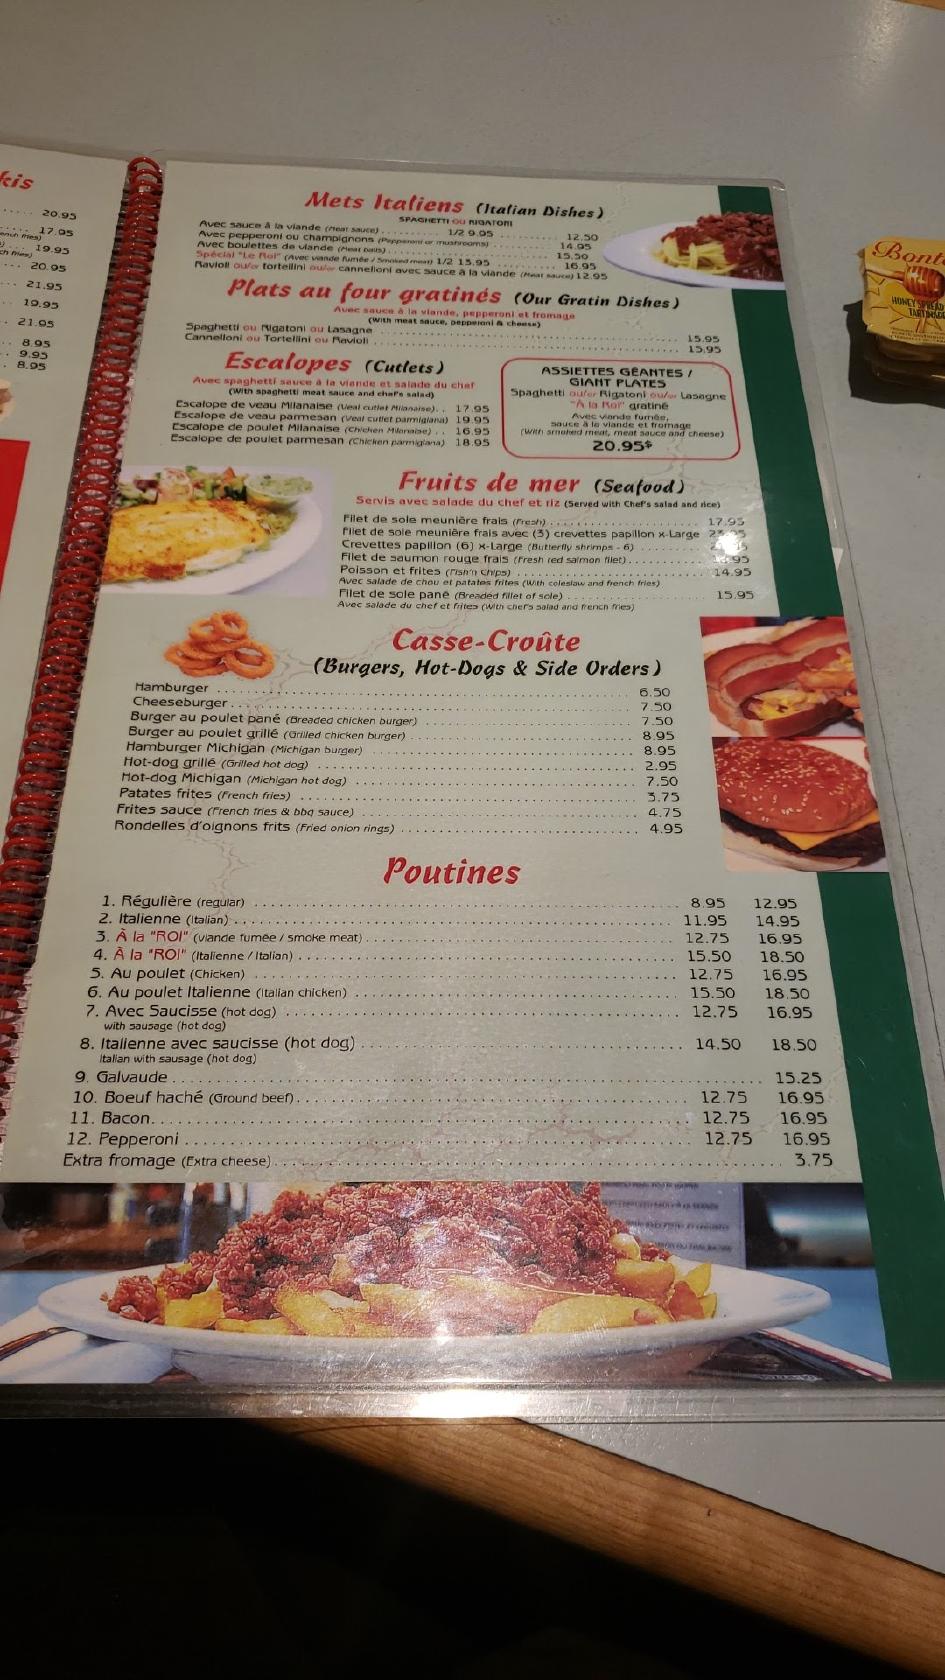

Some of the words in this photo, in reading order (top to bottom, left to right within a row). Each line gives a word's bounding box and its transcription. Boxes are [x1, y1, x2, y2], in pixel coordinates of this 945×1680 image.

[305, 192, 364, 209] Mets
[374, 194, 464, 213] Italiens
[476, 203, 537, 217] (Italian
[543, 206, 604, 220] Dishes)
[42, 210, 77, 220] 20.95
[399, 216, 449, 224] SPAGHETTI
[469, 219, 513, 227] RIGATONI
[200, 220, 226, 228] Avec
[287, 223, 321, 231] viande
[351, 226, 378, 234] sauce)
[567, 233, 598, 241] 12.50
[31, 262, 66, 272] 20.95
[227, 279, 291, 298] Plats
[300, 285, 332, 298] au
[340, 282, 391, 304] four
[399, 283, 501, 305] gratinés
[514, 292, 551, 306] (Our
[558, 294, 609, 307] Gratin
[616, 296, 679, 309] Dishes)
[24, 299, 59, 309] 19.95
[891, 296, 916, 307] HONEY
[186, 322, 240, 332] Spaghetti
[261, 324, 306, 334] Rigatoni
[328, 326, 372, 335] Lasagne
[687, 335, 720, 343] 15.95
[22, 339, 50, 348] 8.95
[225, 352, 352, 375] Escalopes
[366, 360, 444, 375] (Cutlets)
[542, 367, 614, 376] ASSIETTES
[620, 367, 683, 377] GÉANTES
[570, 378, 611, 386] GIANT
[617, 379, 666, 388] PLATES
[176, 400, 227, 410] Escalope
[231, 401, 245, 409] de
[249, 402, 277, 410] veau
[281, 402, 333, 411] Milanaise
[337, 400, 361, 412] (Veal
[364, 402, 389, 412] cutlet
[390, 403, 436, 413] Milanaise)
[456, 405, 490, 413] 17.95
[593, 440, 652, 451] 20.95$
[399, 471, 477, 491] Fruits
[487, 472, 518, 492] de
[529, 478, 580, 492] mer
[595, 479, 684, 496] (Seafood)
[343, 515, 368, 523] Filet
[373, 515, 388, 523] de
[392, 515, 417, 523] sole
[421, 516, 478, 524] meunière
[483, 517, 508, 525] frais
[513, 518, 546, 527] (Fresh)
[709, 517, 744, 526] 17.95
[393, 628, 580, 652] Casse-Croûte
[314, 656, 405, 678] (Burgers,
[415, 660, 505, 679] Hot-Dogs
[513, 660, 527, 676] &
[535, 660, 577, 676] Side
[586, 660, 661, 677] Orders)
[136, 682, 208, 695] Hamburger
[640, 688, 670, 697] 6.50
[133, 696, 228, 710] Cheeseburger
[641, 702, 672, 712] 7.50
[131, 711, 176, 724] Burger
[180, 714, 196, 722] au
[201, 713, 243, 725] poulet
[248, 713, 280, 725] pané
[642, 717, 673, 726] 7.50
[126, 741, 202, 754] Hamburger
[207, 742, 265, 755] Michigan
[644, 746, 676, 755] 8.95
[124, 757, 178, 769] Hot-dog
[183, 757, 215, 769] grillé
[645, 761, 677, 771] 2.95
[119, 788, 171, 799] Patates
[177, 788, 212, 799] frites
[648, 792, 679, 802] 3.75
[116, 804, 156, 815] Frites
[160, 806, 202, 815] sauce
[648, 808, 681, 818] 4.75
[114, 820, 185, 831] Rondelles
[263, 821, 290, 832] frits
[650, 824, 683, 834] 4.95
[384, 856, 520, 885] Poutines
[102, 895, 116, 906] 1.
[122, 895, 192, 909] Régulière
[197, 897, 245, 908] (regular)
[690, 897, 725, 909] 8.95
[754, 898, 797, 909] 12.95
[99, 913, 112, 924] 2.
[119, 912, 181, 924] Italienne
[186, 914, 229, 926] (Italian)
[684, 915, 727, 927] 11.95
[756, 915, 800, 927] 14.95
[96, 931, 109, 942] 3.
[133, 931, 144, 942] la
[151, 930, 188, 942] "ROI"
[193, 932, 235, 944] (viande
[240, 932, 276, 942] fumée
[279, 933, 284, 942] /
[288, 933, 326, 942] smoke
[329, 933, 362, 943] meat)
[686, 933, 729, 944] 12.75
[759, 933, 802, 945] 16.95
[90, 968, 104, 979] 5.
[111, 968, 131, 979] Au
[136, 968, 185, 982] poulet
[190, 969, 245, 981] (Chicken)
[689, 969, 733, 981] 12.75
[763, 969, 808, 981] 16.95
[86, 1005, 99, 1017] 7.
[106, 1005, 144, 1017] Avec
[149, 1005, 217, 1018] Saucisse
[222, 1006, 246, 1018] (hot
[249, 1006, 277, 1019] dog)
[693, 1005, 738, 1018] 12.75
[767, 1006, 812, 1019] 16.95
[74, 1071, 88, 1083] 9.
[96, 1071, 168, 1083] Galvaude
[775, 1072, 822, 1084] 15.25
[73, 1091, 97, 1103] 10.
[104, 1091, 152, 1104] Boeuf
[157, 1090, 203, 1104] haché
[209, 1092, 257, 1105] (Ground
[261, 1092, 294, 1104] beef)
[701, 1091, 747, 1104] 12.75
[778, 1092, 824, 1104] 16.95
[71, 1111, 95, 1124] 11.
[101, 1111, 150, 1124] Bacon
[703, 1111, 750, 1124] 12.75
[780, 1112, 827, 1124] 16.95
[68, 1132, 92, 1145] 12.
[99, 1132, 178, 1148] Pepperoni
[705, 1132, 752, 1145] 12.75
[783, 1133, 831, 1145] 16.95
[64, 1153, 102, 1167] Extra
[109, 1153, 175, 1170] fromage
[181, 1155, 217, 1168] (Extra
[221, 1155, 271, 1168] cheese)
[795, 1153, 832, 1167] 3.75
